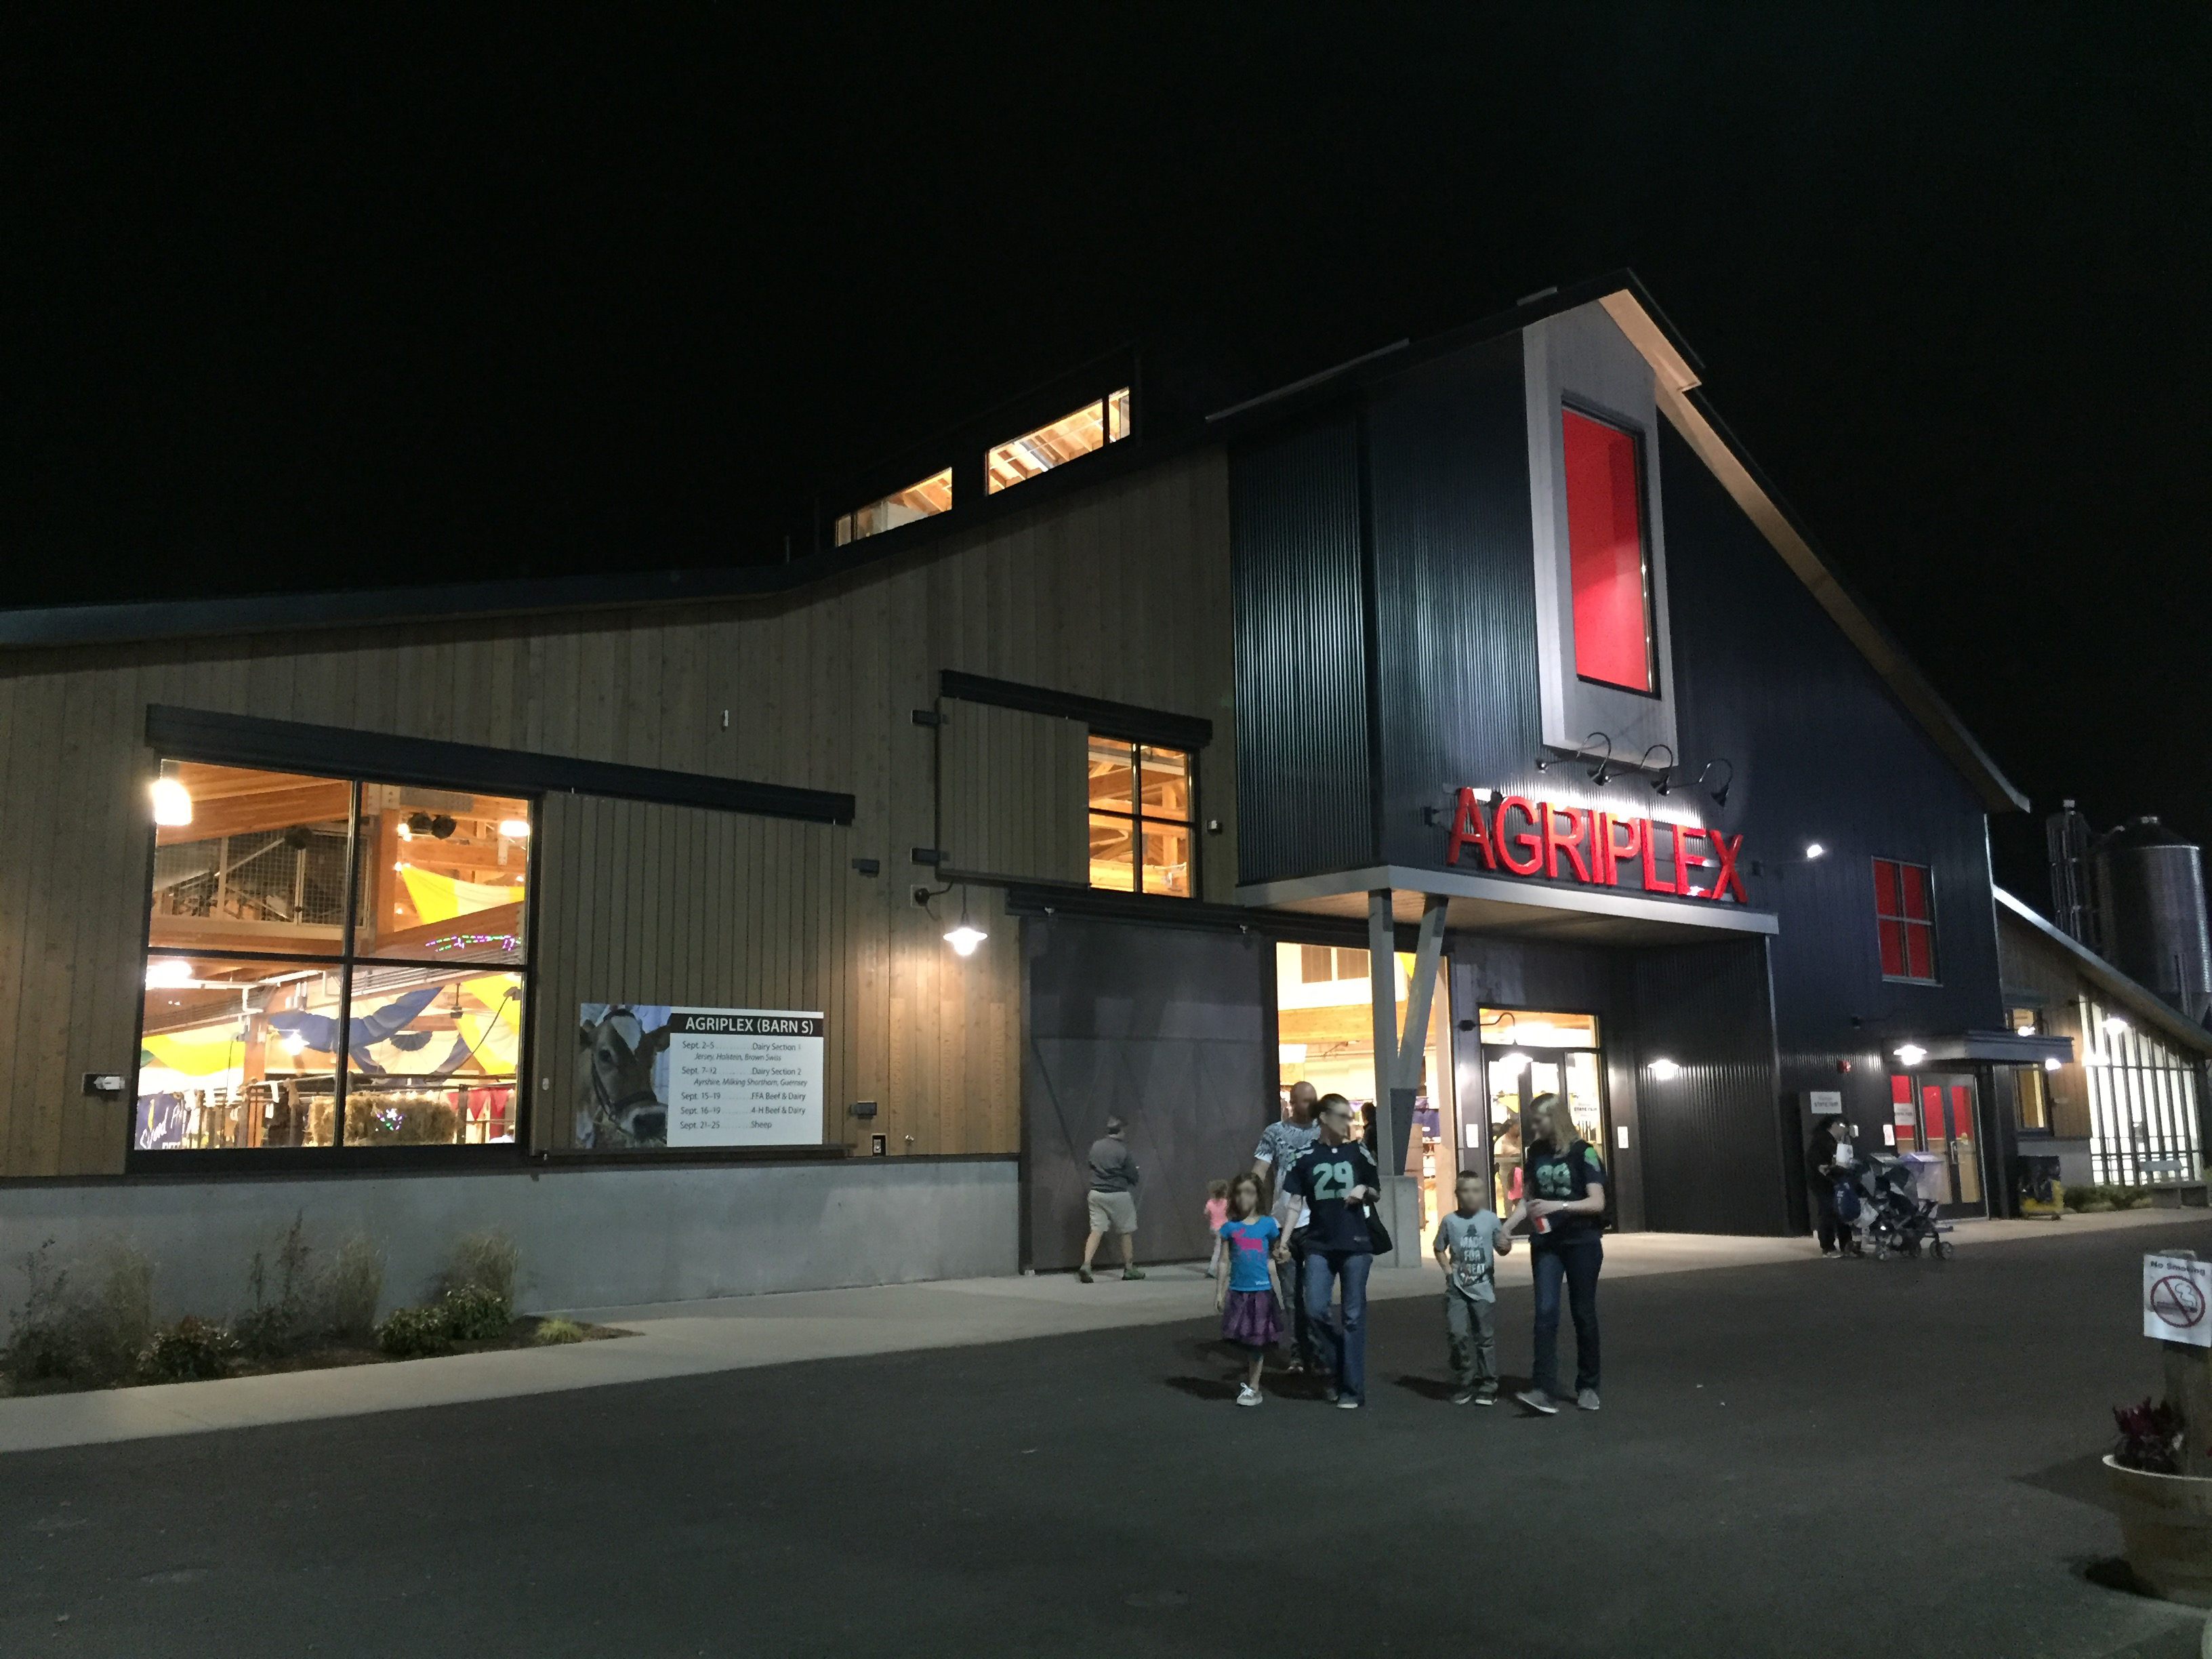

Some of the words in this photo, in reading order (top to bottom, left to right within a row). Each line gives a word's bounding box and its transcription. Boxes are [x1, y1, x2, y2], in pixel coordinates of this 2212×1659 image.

[1446, 786, 1748, 903] AGRIPLEX
[685, 1017, 754, 1032] AGRIPLEX
[757, 1018, 798, 1033] (BARN
[801, 1019, 813, 1035] S)
[752, 1042, 770, 1051] Dairy
[771, 1043, 796, 1051] Section
[752, 1067, 770, 1077] Dairy
[771, 1067, 796, 1076] Section
[780, 1079, 808, 1087] Guernsey
[788, 1092, 806, 1101] Dairy
[765, 1106, 781, 1114] Beef
[788, 1107, 806, 1115] Dairy
[751, 1121, 773, 1130] Sheep
[1313, 1161, 1354, 1200] 29
[2150, 1261, 2163, 1269] No
[2167, 1263, 2205, 1276] Smoking
